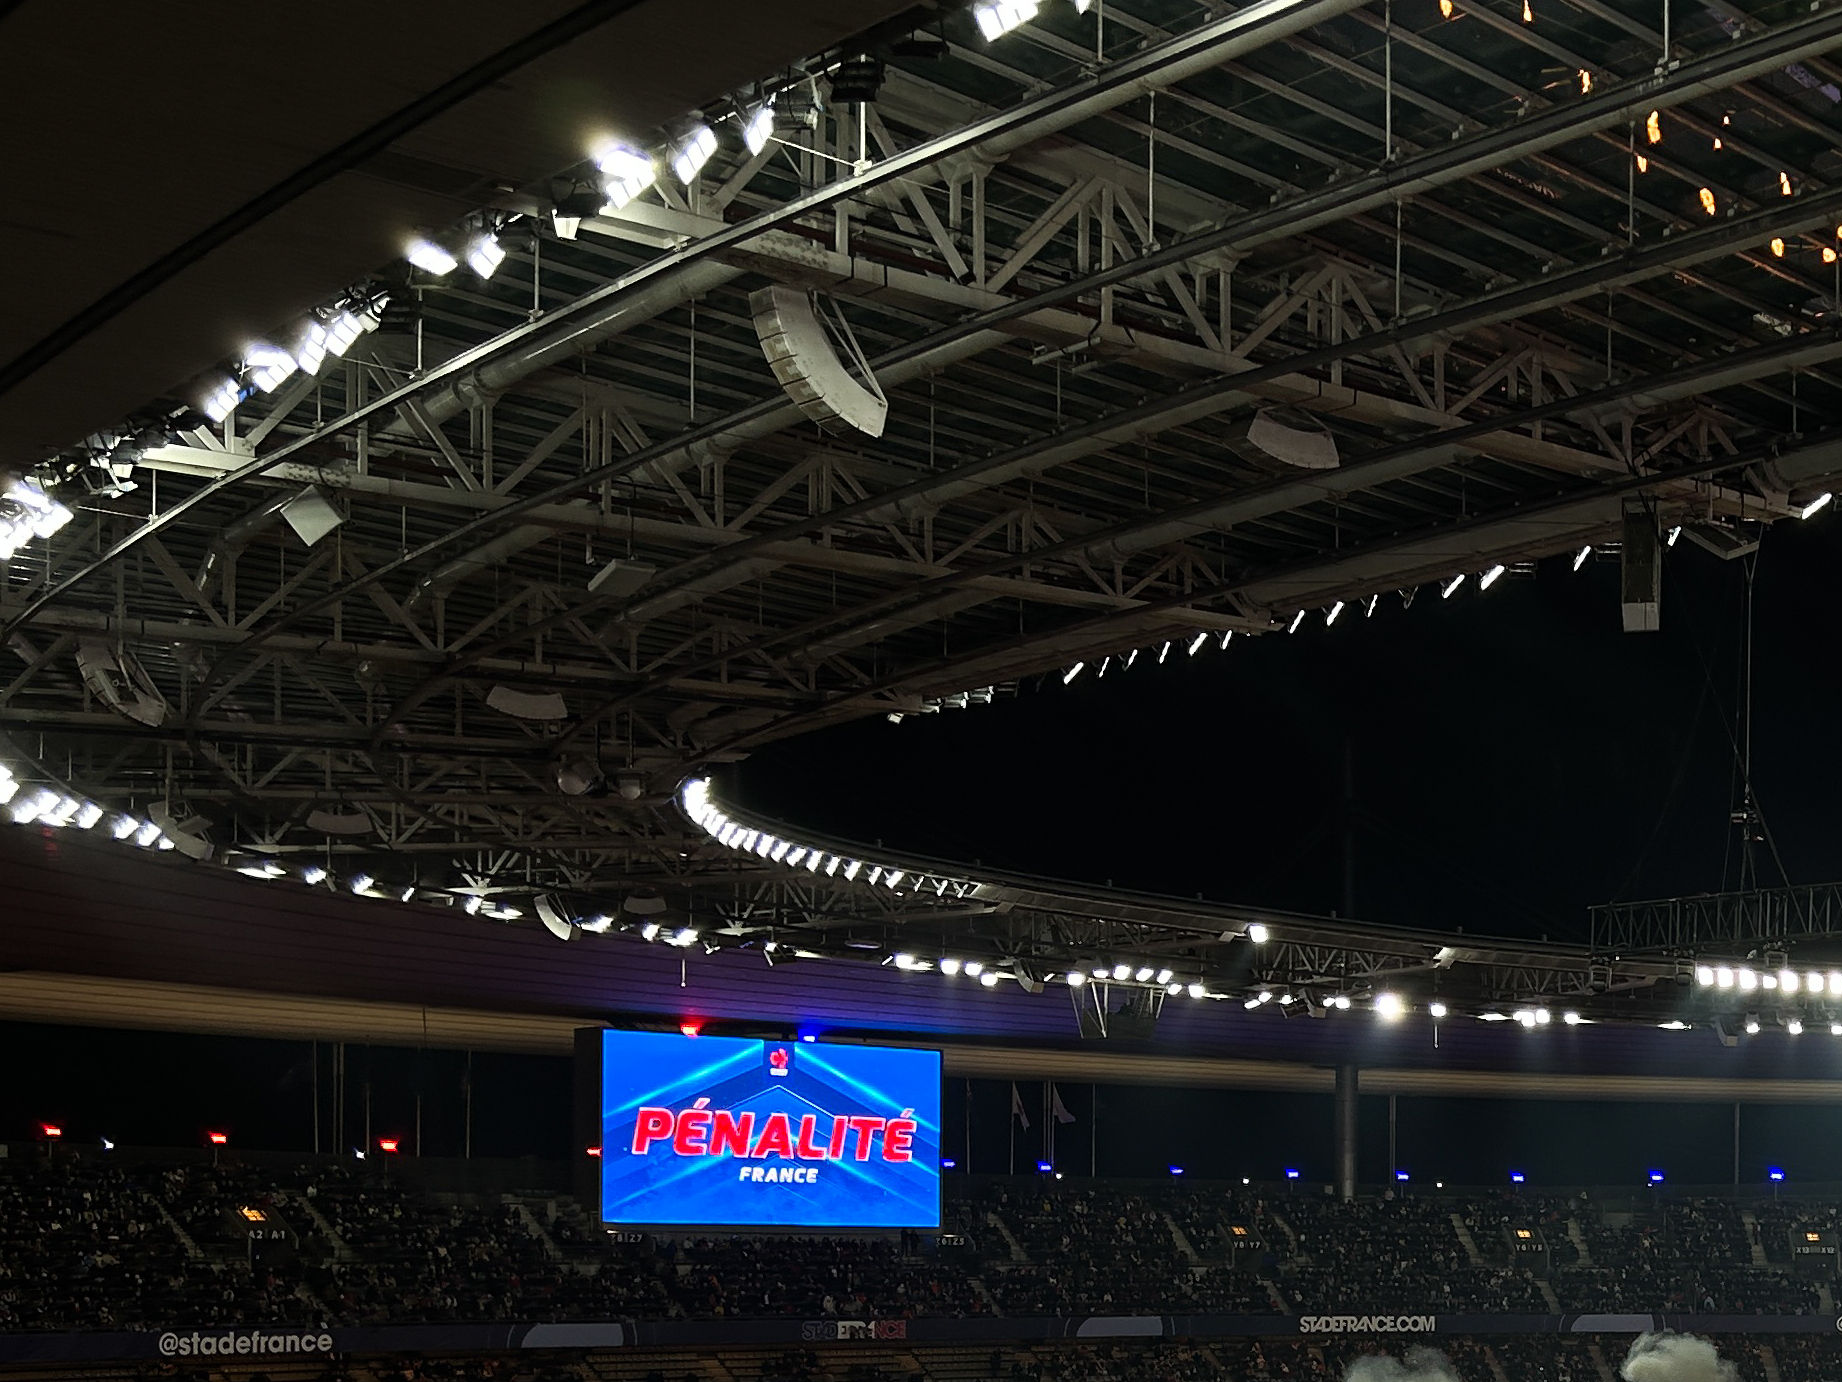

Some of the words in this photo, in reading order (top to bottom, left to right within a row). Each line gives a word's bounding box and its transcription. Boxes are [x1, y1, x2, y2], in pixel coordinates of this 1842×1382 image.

[631, 1097, 918, 1162] PÉNALITÉ
[739, 1167, 819, 1184] FRANCE
[1300, 1315, 1436, 1333] STADEFRANCE.COM
[159, 1331, 333, 1356] @stadefrance
